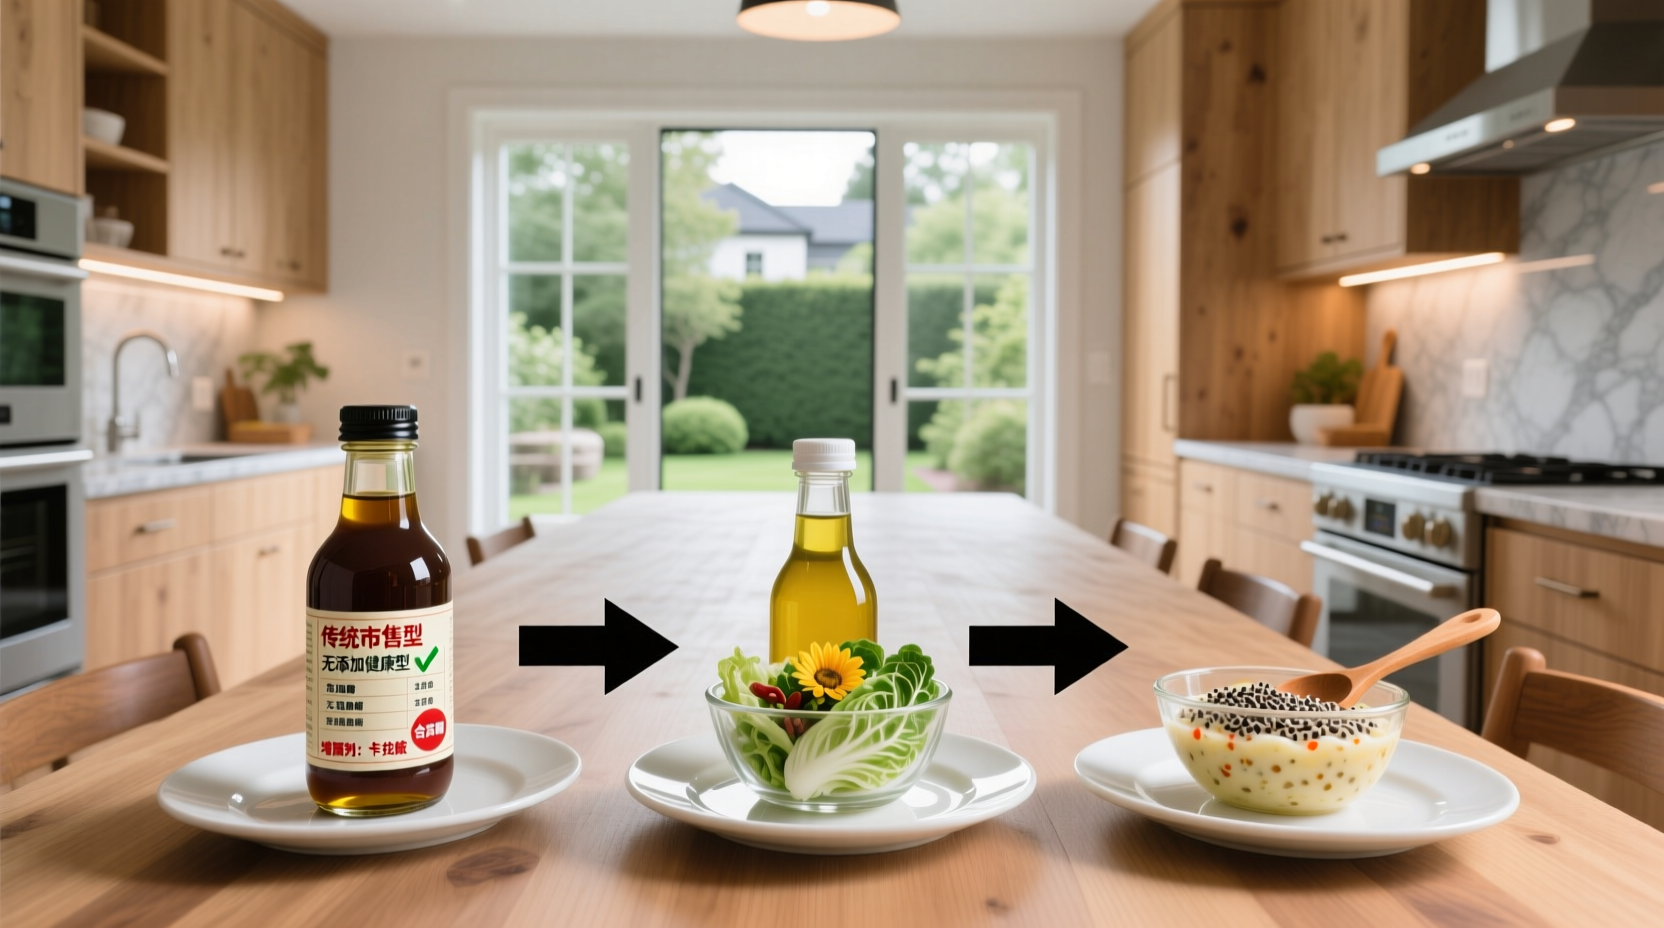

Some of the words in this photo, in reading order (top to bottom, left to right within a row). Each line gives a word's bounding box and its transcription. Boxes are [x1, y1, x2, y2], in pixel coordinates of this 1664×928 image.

[321, 623, 423, 649] 传统市售型
